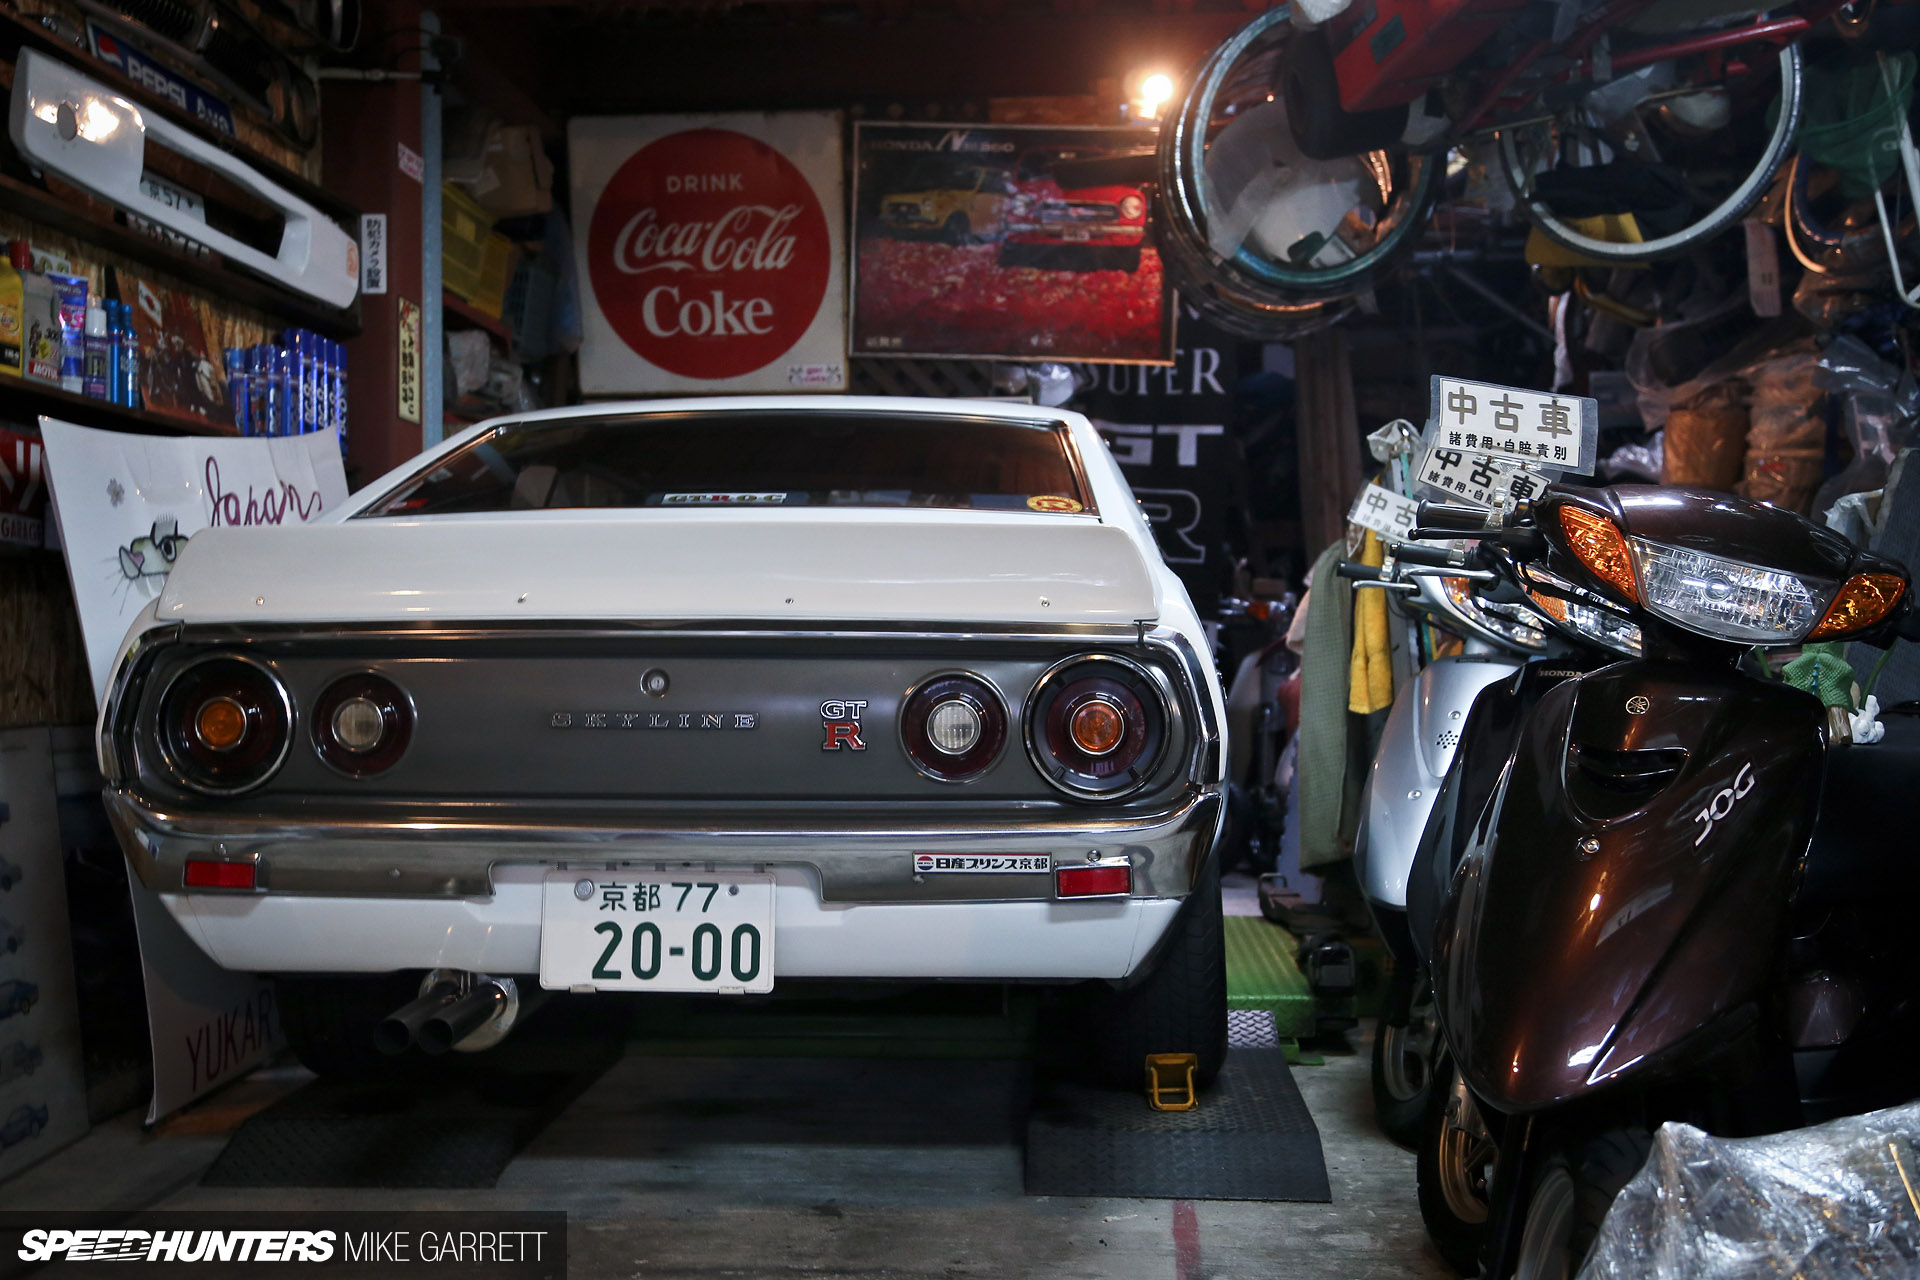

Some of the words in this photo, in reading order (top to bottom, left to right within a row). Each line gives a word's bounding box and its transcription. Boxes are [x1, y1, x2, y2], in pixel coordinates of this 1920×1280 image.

[127, 55, 187, 111] PEPSI
[666, 173, 743, 194] DRINK
[613, 204, 804, 275] Coca-Cola
[642, 285, 774, 338] Coke
[1447, 386, 1572, 439] 中古車
[1095, 418, 1225, 467] GT
[1449, 431, 1568, 461] 諸費用・自賠責別
[1133, 486, 1207, 564] R
[1538, 668, 1582, 678] HONDA
[551, 712, 756, 729] SKYLINE
[820, 700, 867, 720] GT
[822, 720, 867, 751] R
[1694, 761, 1756, 847] JOG
[935, 857, 1048, 870] 日産プリンス京都
[599, 881, 661, 912] 京都
[671, 882, 719, 913] 77
[592, 921, 761, 982] 20-00
